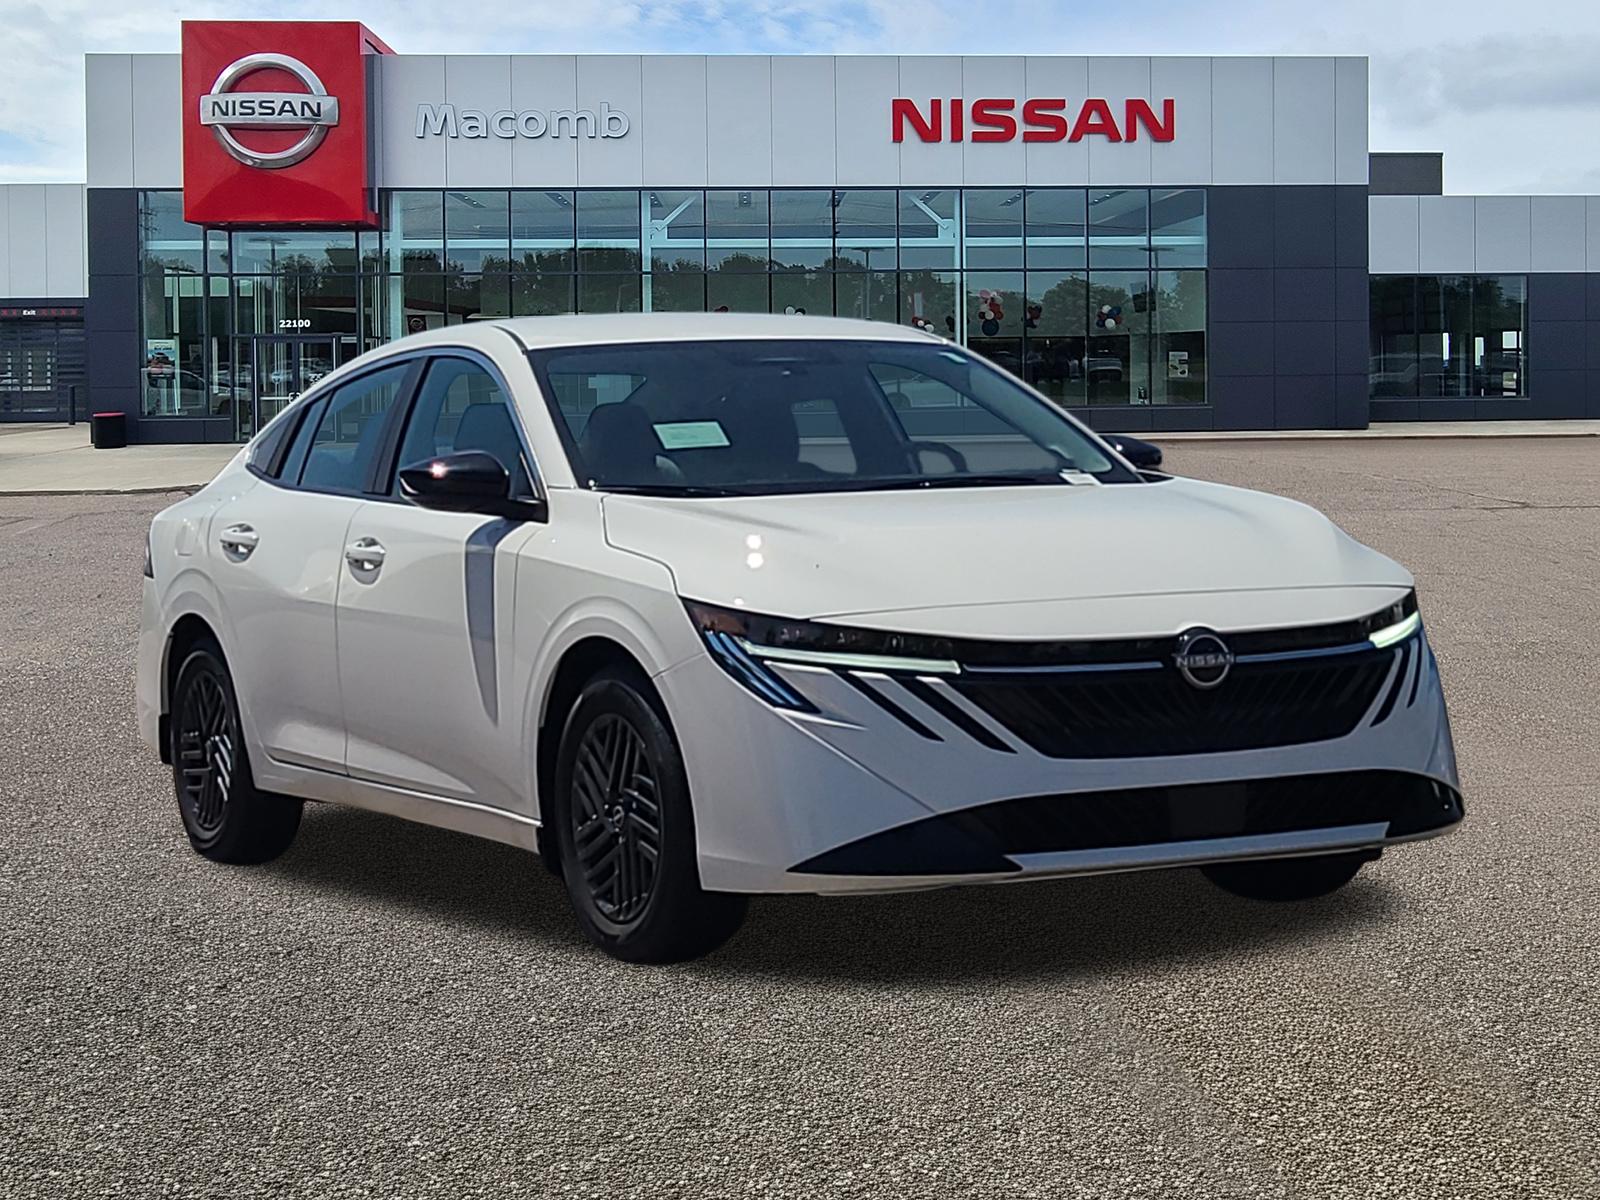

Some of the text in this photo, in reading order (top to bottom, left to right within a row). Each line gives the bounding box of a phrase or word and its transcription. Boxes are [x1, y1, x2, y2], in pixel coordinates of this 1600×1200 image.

[211, 100, 322, 118] NISSAN
[415, 102, 630, 139] Macomb
[892, 98, 1176, 143] NISSAN
[279, 319, 311, 328] 22100
[1176, 653, 1234, 668] NISSAN
